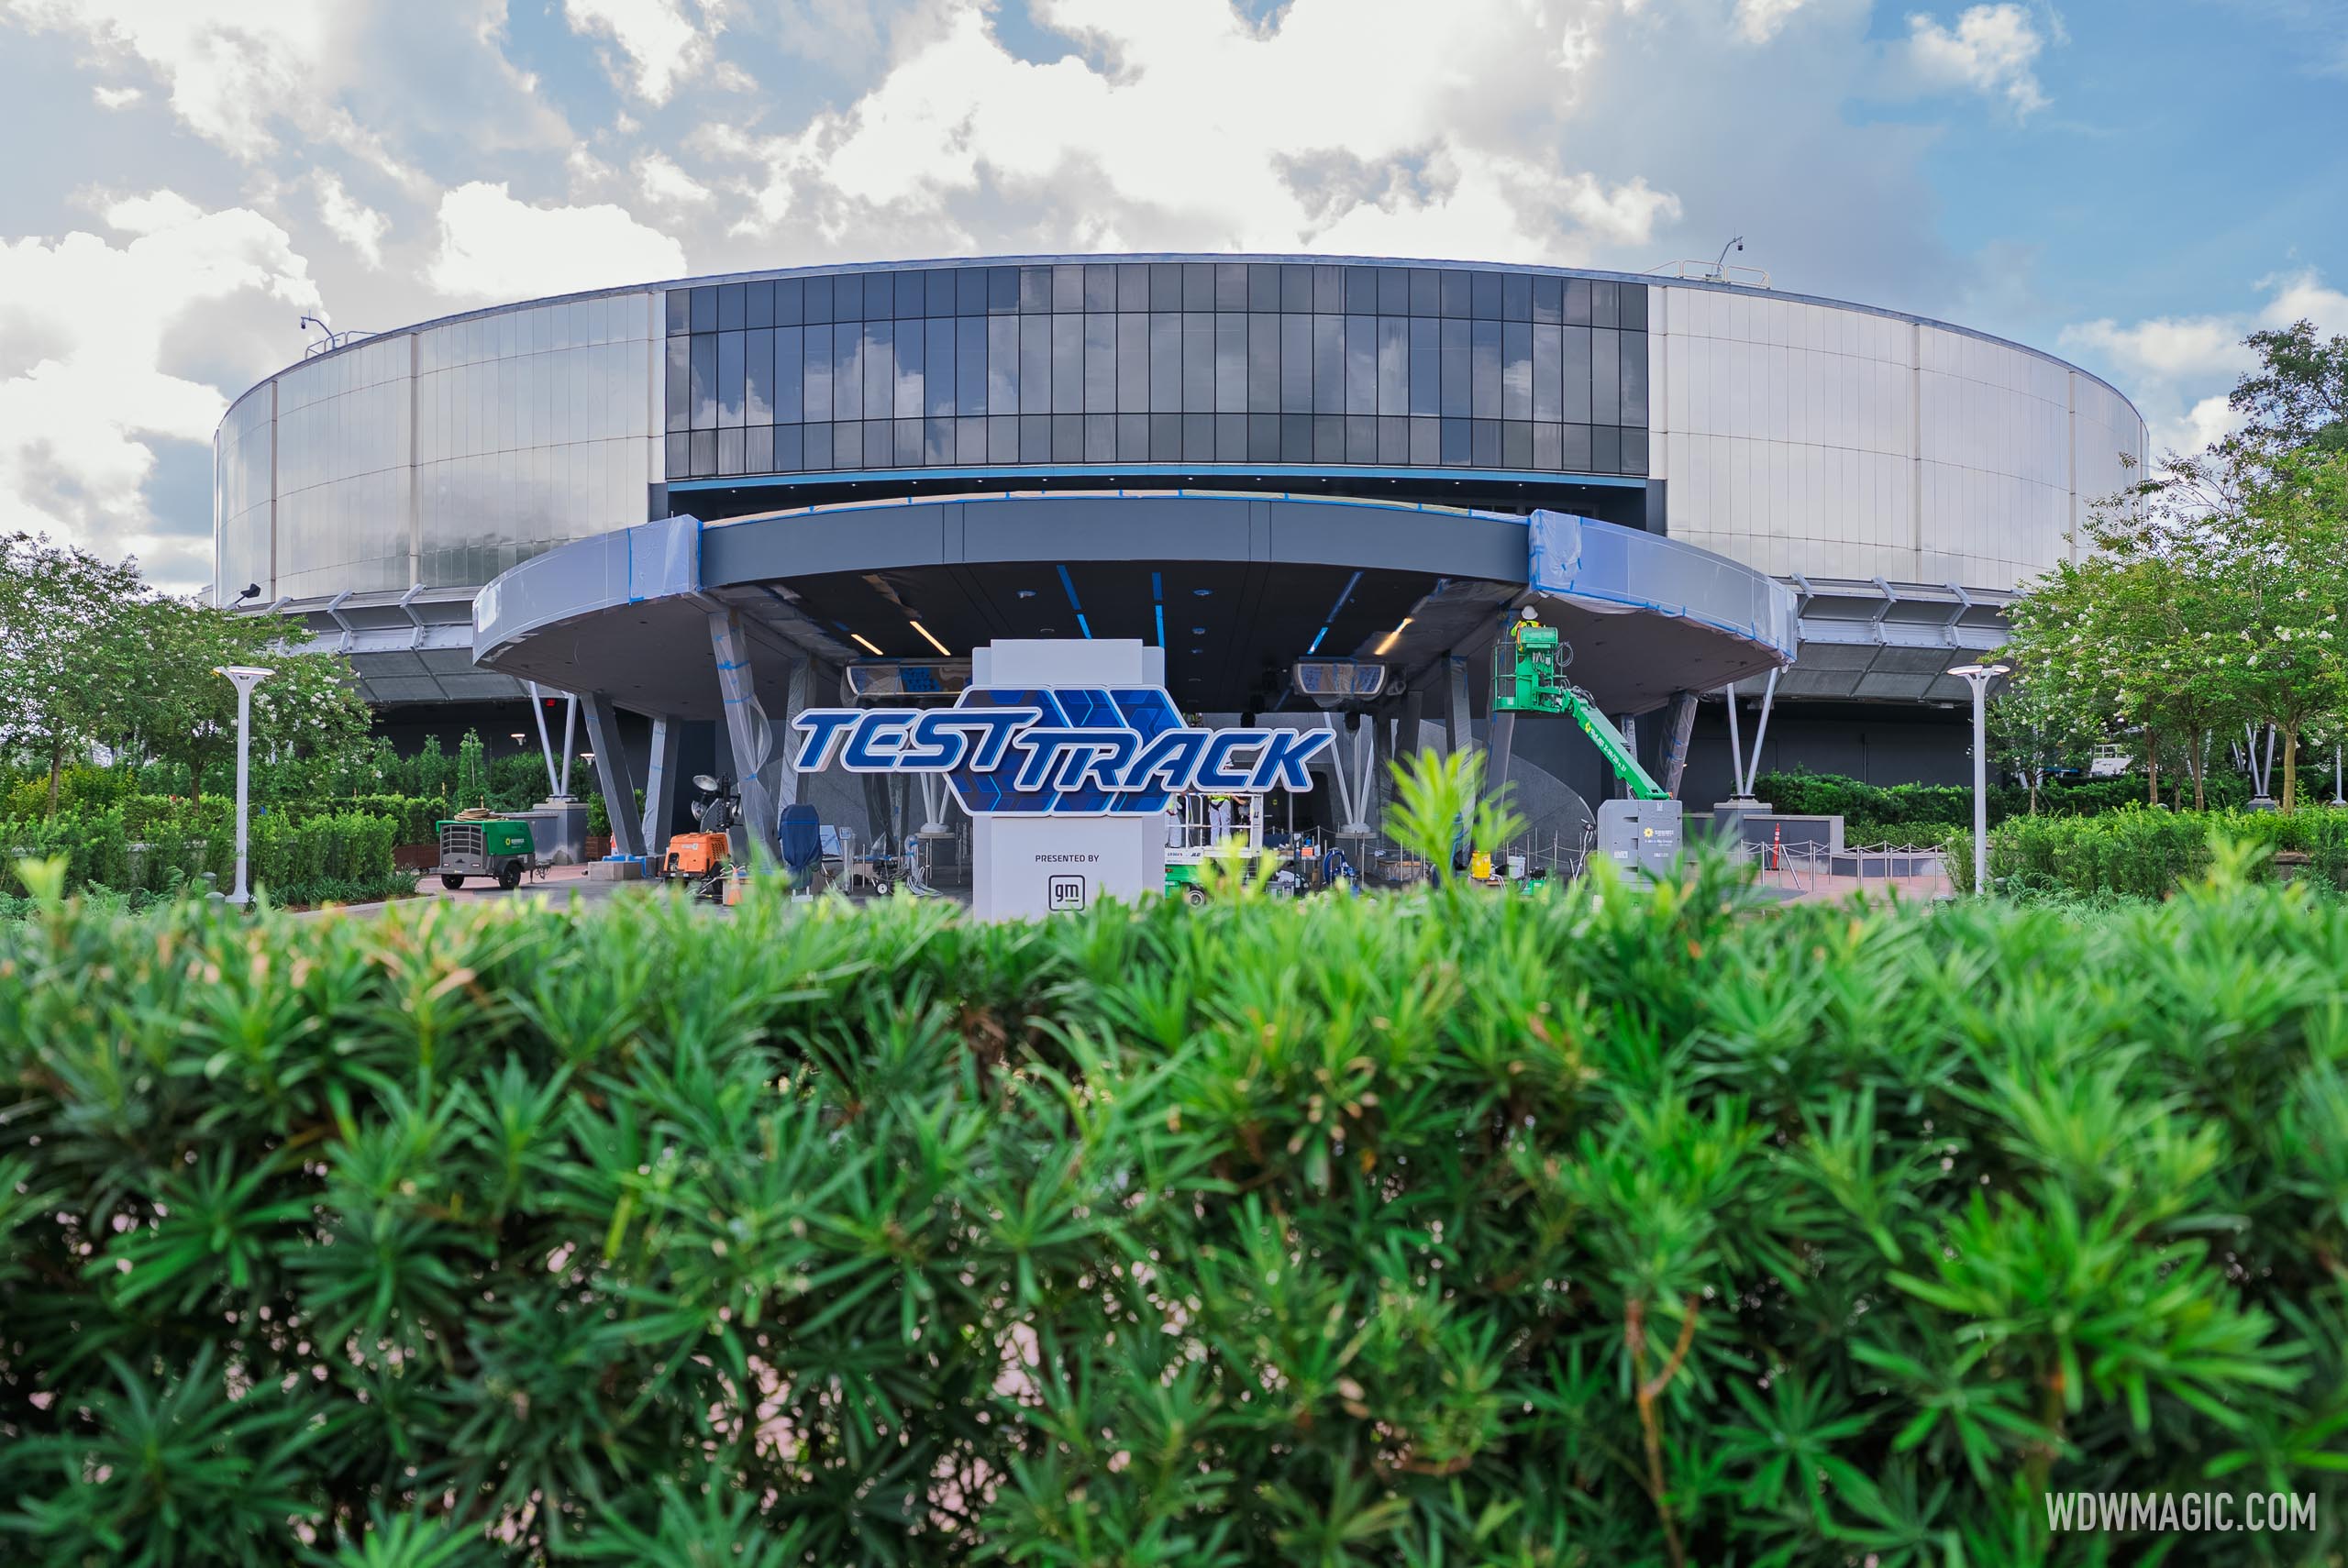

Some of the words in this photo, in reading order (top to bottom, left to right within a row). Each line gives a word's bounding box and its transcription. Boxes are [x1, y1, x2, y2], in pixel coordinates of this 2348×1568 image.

[792, 709, 1042, 772] TEST
[1013, 728, 1336, 792] TRACK
[1035, 855, 1086, 863] PRESENTED
[1088, 855, 1100, 863] BY
[1055, 884, 1080, 902] gm
